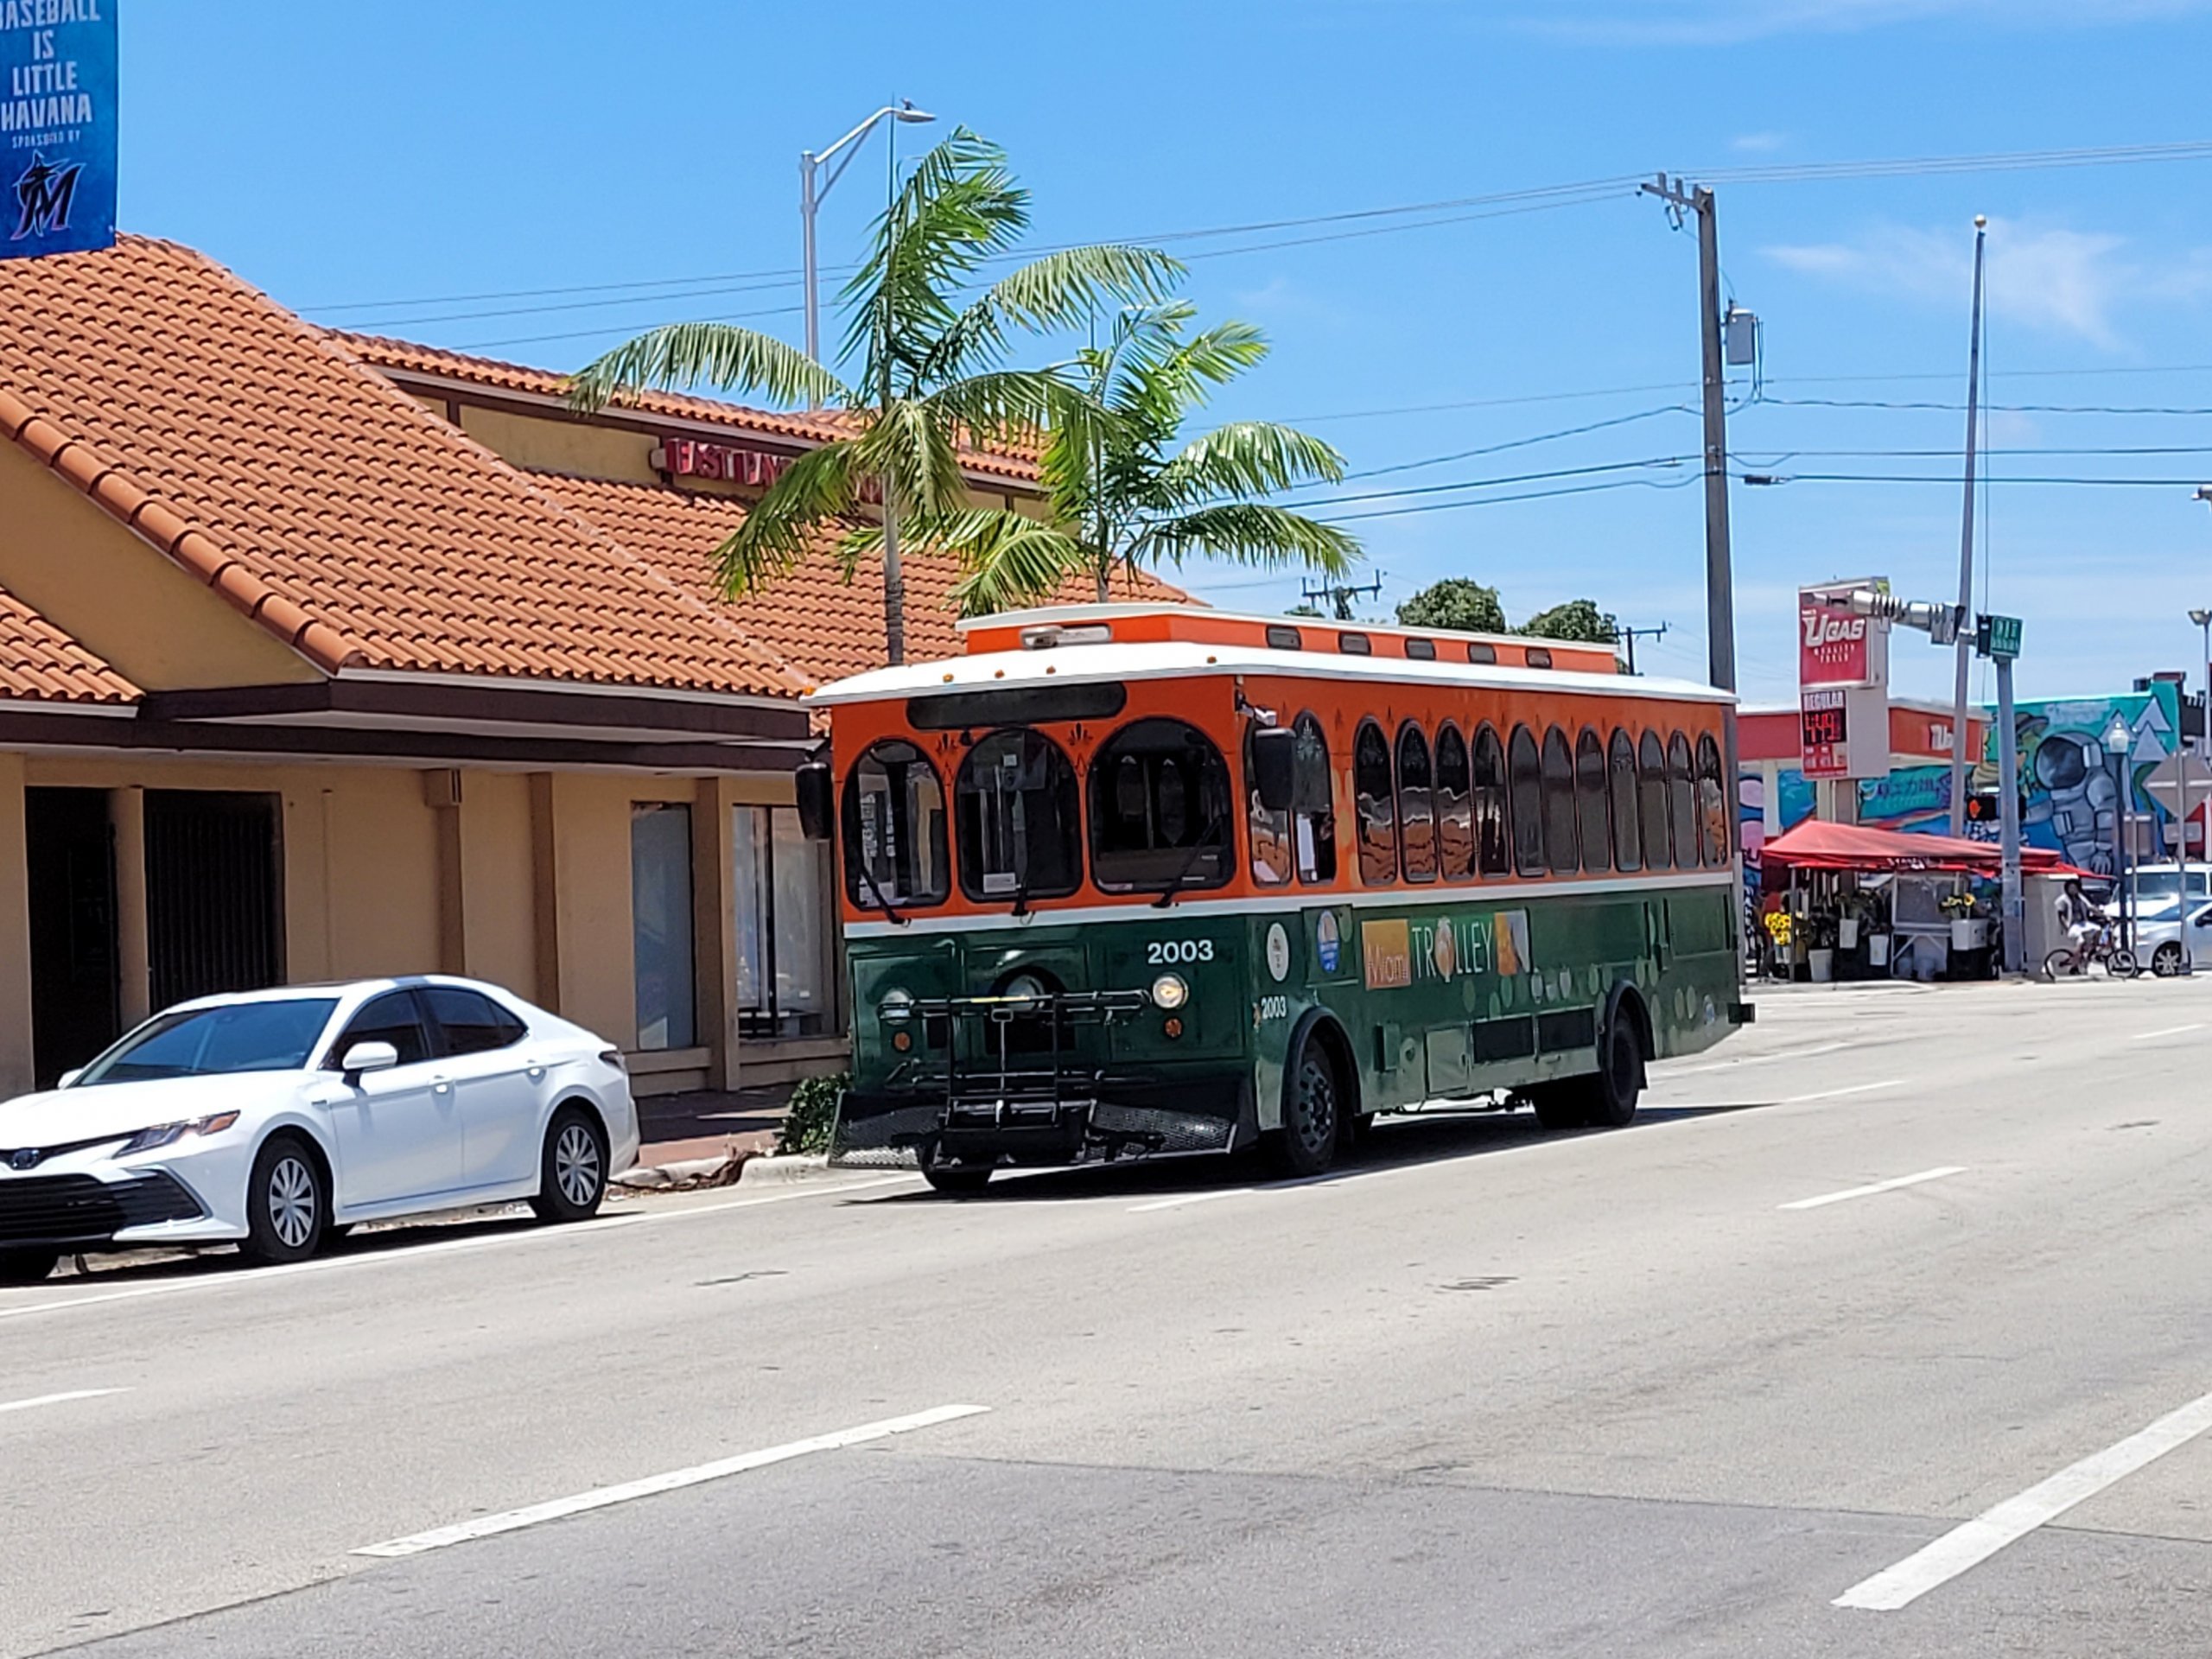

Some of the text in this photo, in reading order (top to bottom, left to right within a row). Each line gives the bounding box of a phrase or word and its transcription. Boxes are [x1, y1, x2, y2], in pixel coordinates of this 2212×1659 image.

[33, 29, 54, 60] IS
[12, 60, 78, 97] LITTLE
[1, 93, 92, 130] HAVANA
[1147, 939, 1214, 964] 2003
[1262, 995, 1286, 1020] 2003
